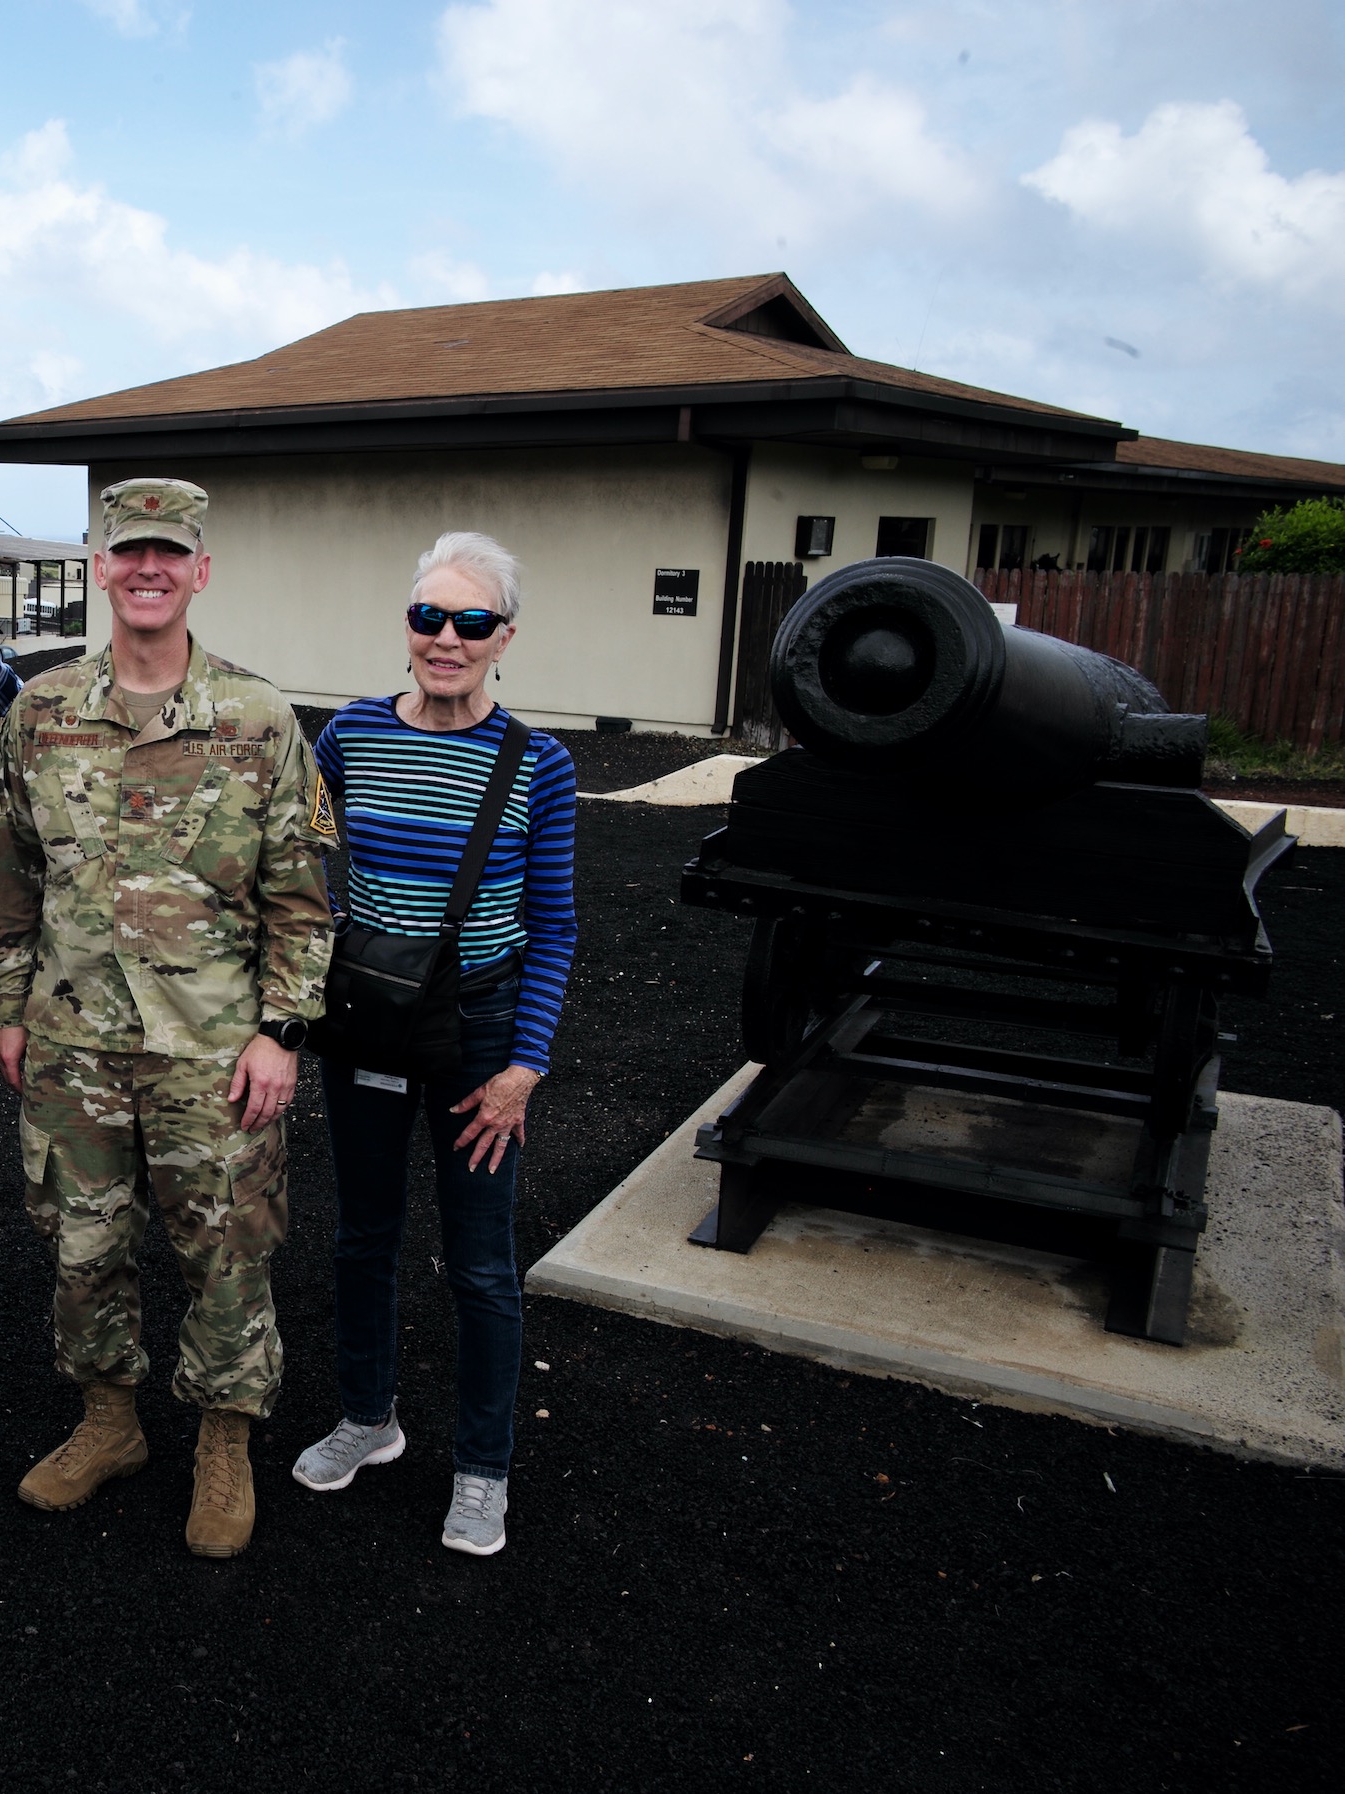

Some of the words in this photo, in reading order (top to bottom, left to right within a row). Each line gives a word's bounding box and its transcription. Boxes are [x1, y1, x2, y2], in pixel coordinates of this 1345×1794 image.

[656, 595, 674, 603] Building
[187, 743, 206, 755] U.S.
[209, 744, 226, 756] AIR
[230, 744, 263, 756] FORCE
